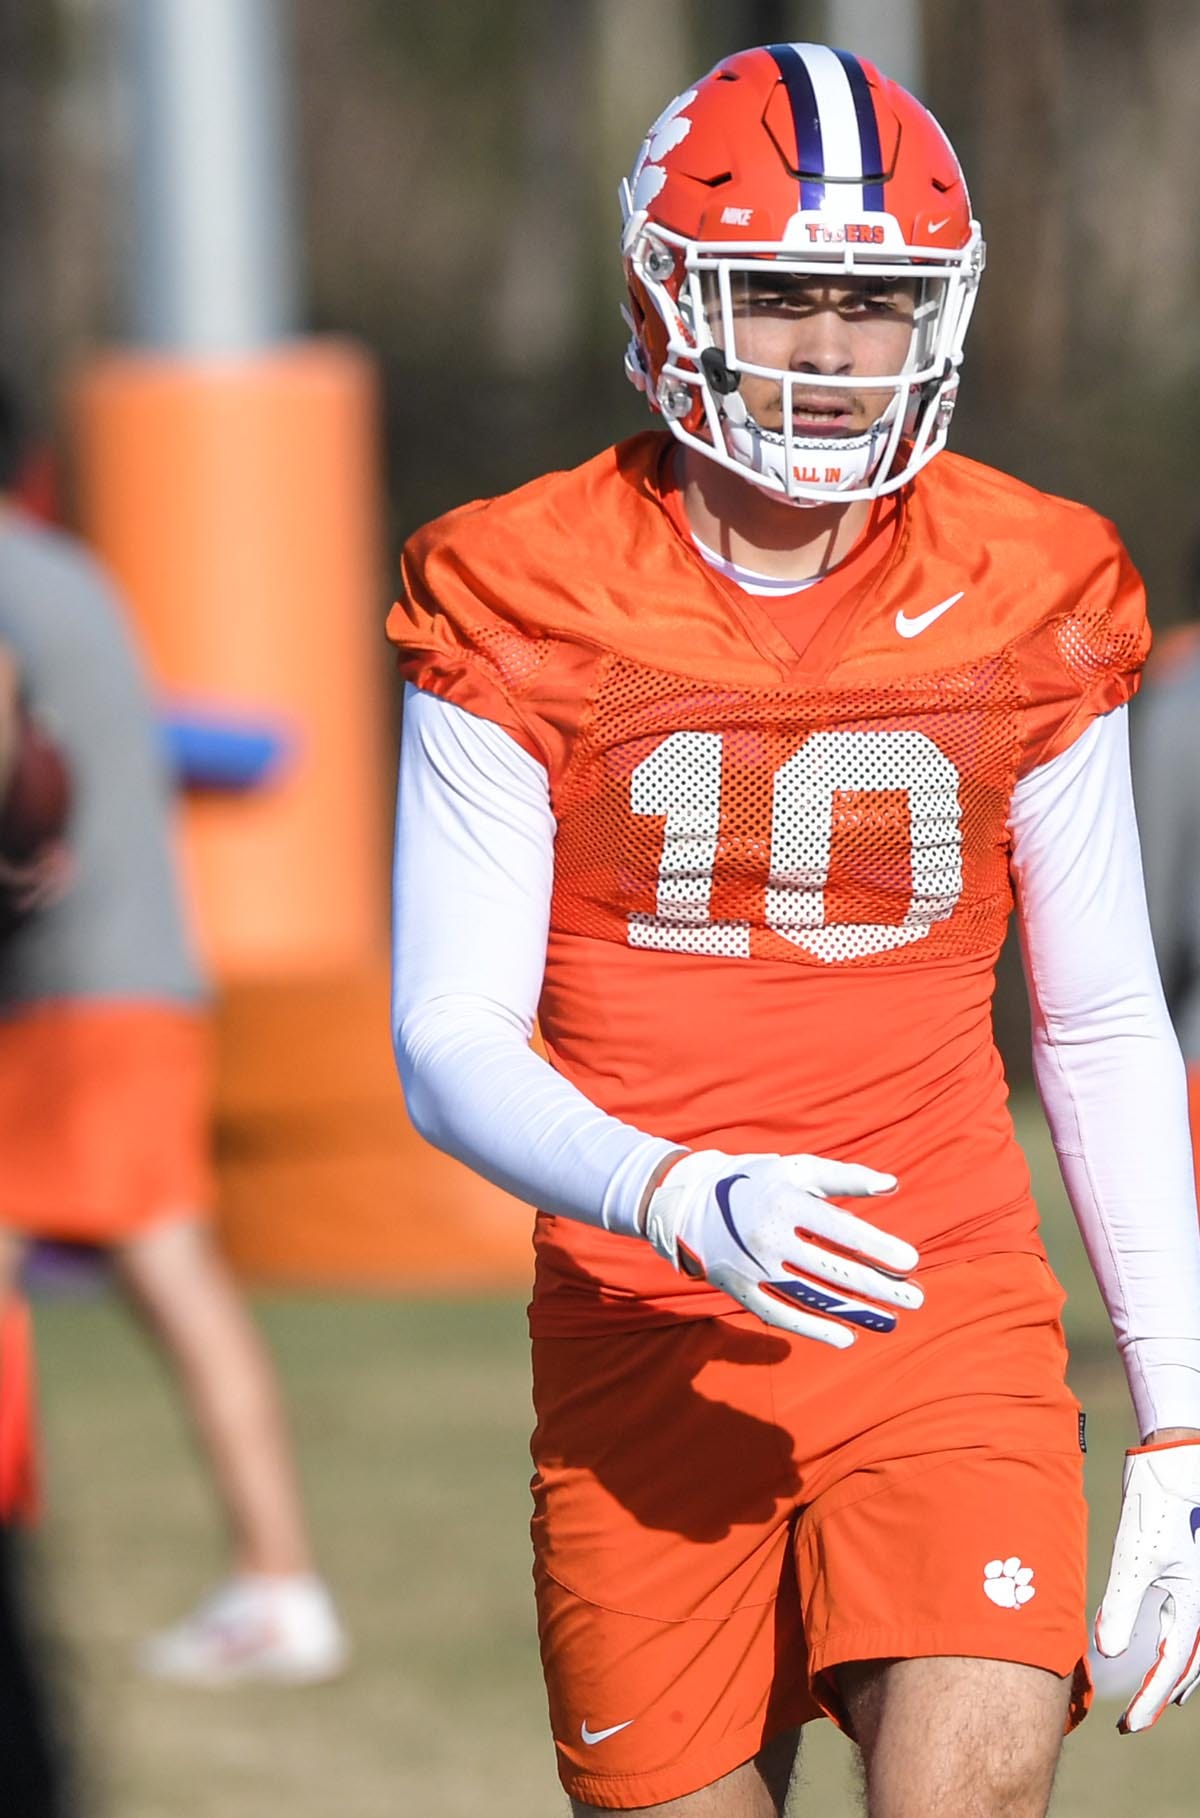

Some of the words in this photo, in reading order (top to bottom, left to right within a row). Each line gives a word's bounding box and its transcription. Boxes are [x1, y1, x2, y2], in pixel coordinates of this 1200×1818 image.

[720, 207, 754, 226] NIKE
[825, 467, 841, 483] IN
[627, 730, 963, 963] 10
